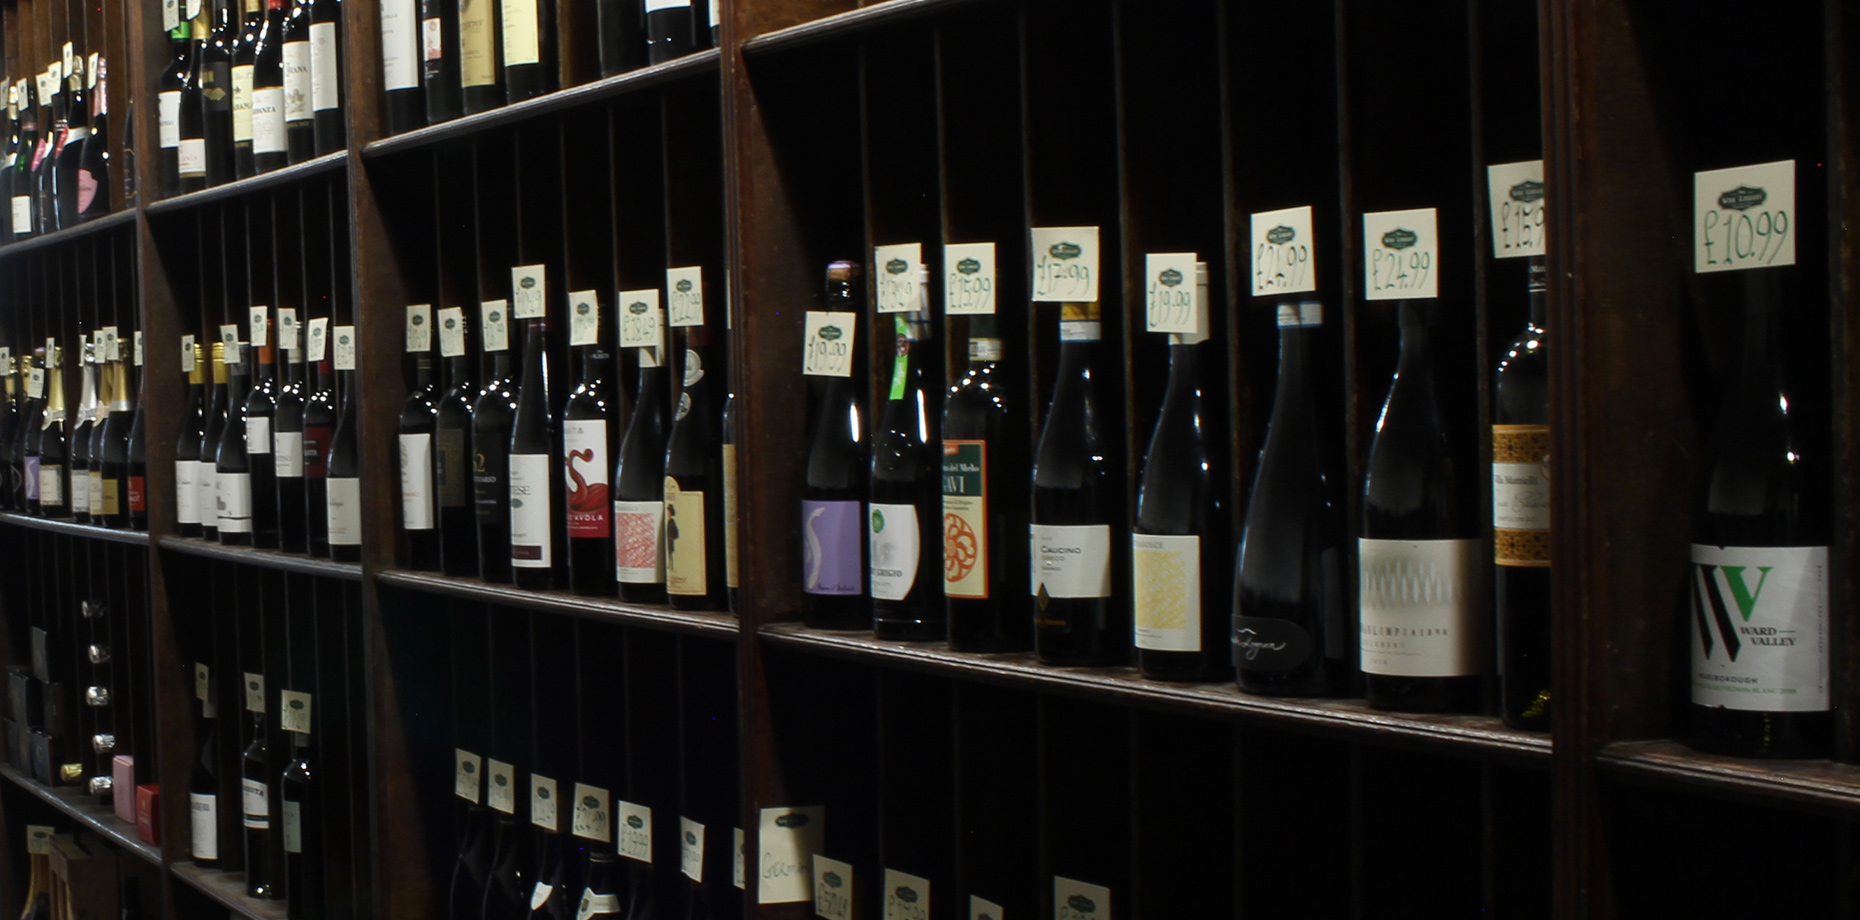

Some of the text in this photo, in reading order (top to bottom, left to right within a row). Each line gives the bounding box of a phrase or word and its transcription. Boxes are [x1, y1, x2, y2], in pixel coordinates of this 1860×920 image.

[1704, 210, 1789, 265] £10.99
[1036, 255, 1091, 297] £17.99
[1372, 248, 1431, 292] £24.99
[1148, 282, 1192, 327] £19.99
[806, 334, 847, 373] £19.99
[1740, 626, 1778, 636] WARD
[1750, 637, 1797, 647] VALLEY
